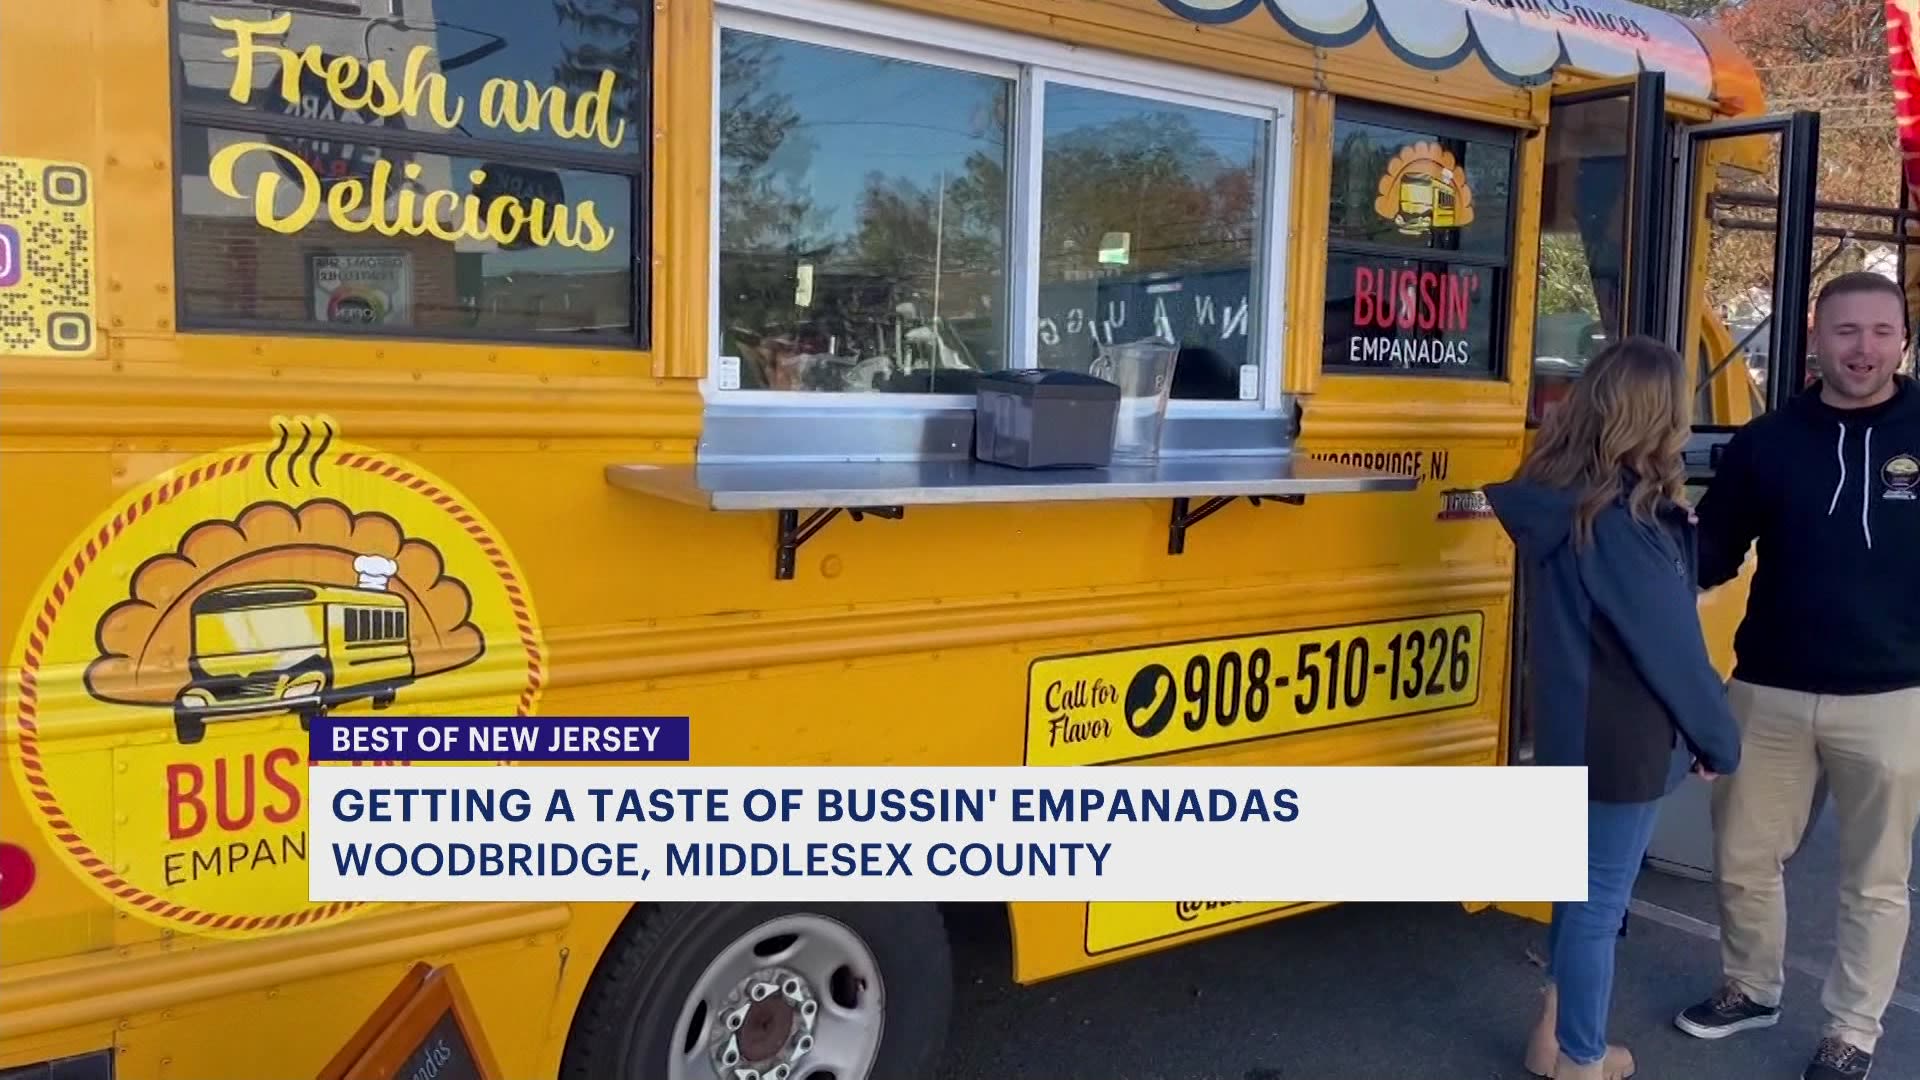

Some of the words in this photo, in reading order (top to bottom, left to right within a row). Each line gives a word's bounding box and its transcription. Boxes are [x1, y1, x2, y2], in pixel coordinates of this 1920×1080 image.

[1549, 0, 1650, 41] Sauces
[210, 12, 466, 129] Fresh
[480, 69, 625, 148] and
[208, 141, 614, 252] Delicious
[1353, 266, 1479, 330] BUSSIN'
[1349, 335, 1470, 365] EMPANADAS
[1430, 450, 1449, 481] NJ
[1045, 679, 1087, 713] Call
[1091, 677, 1119, 708] for
[1183, 625, 1471, 732] 908-510-1326
[1047, 712, 1112, 748] Flavor
